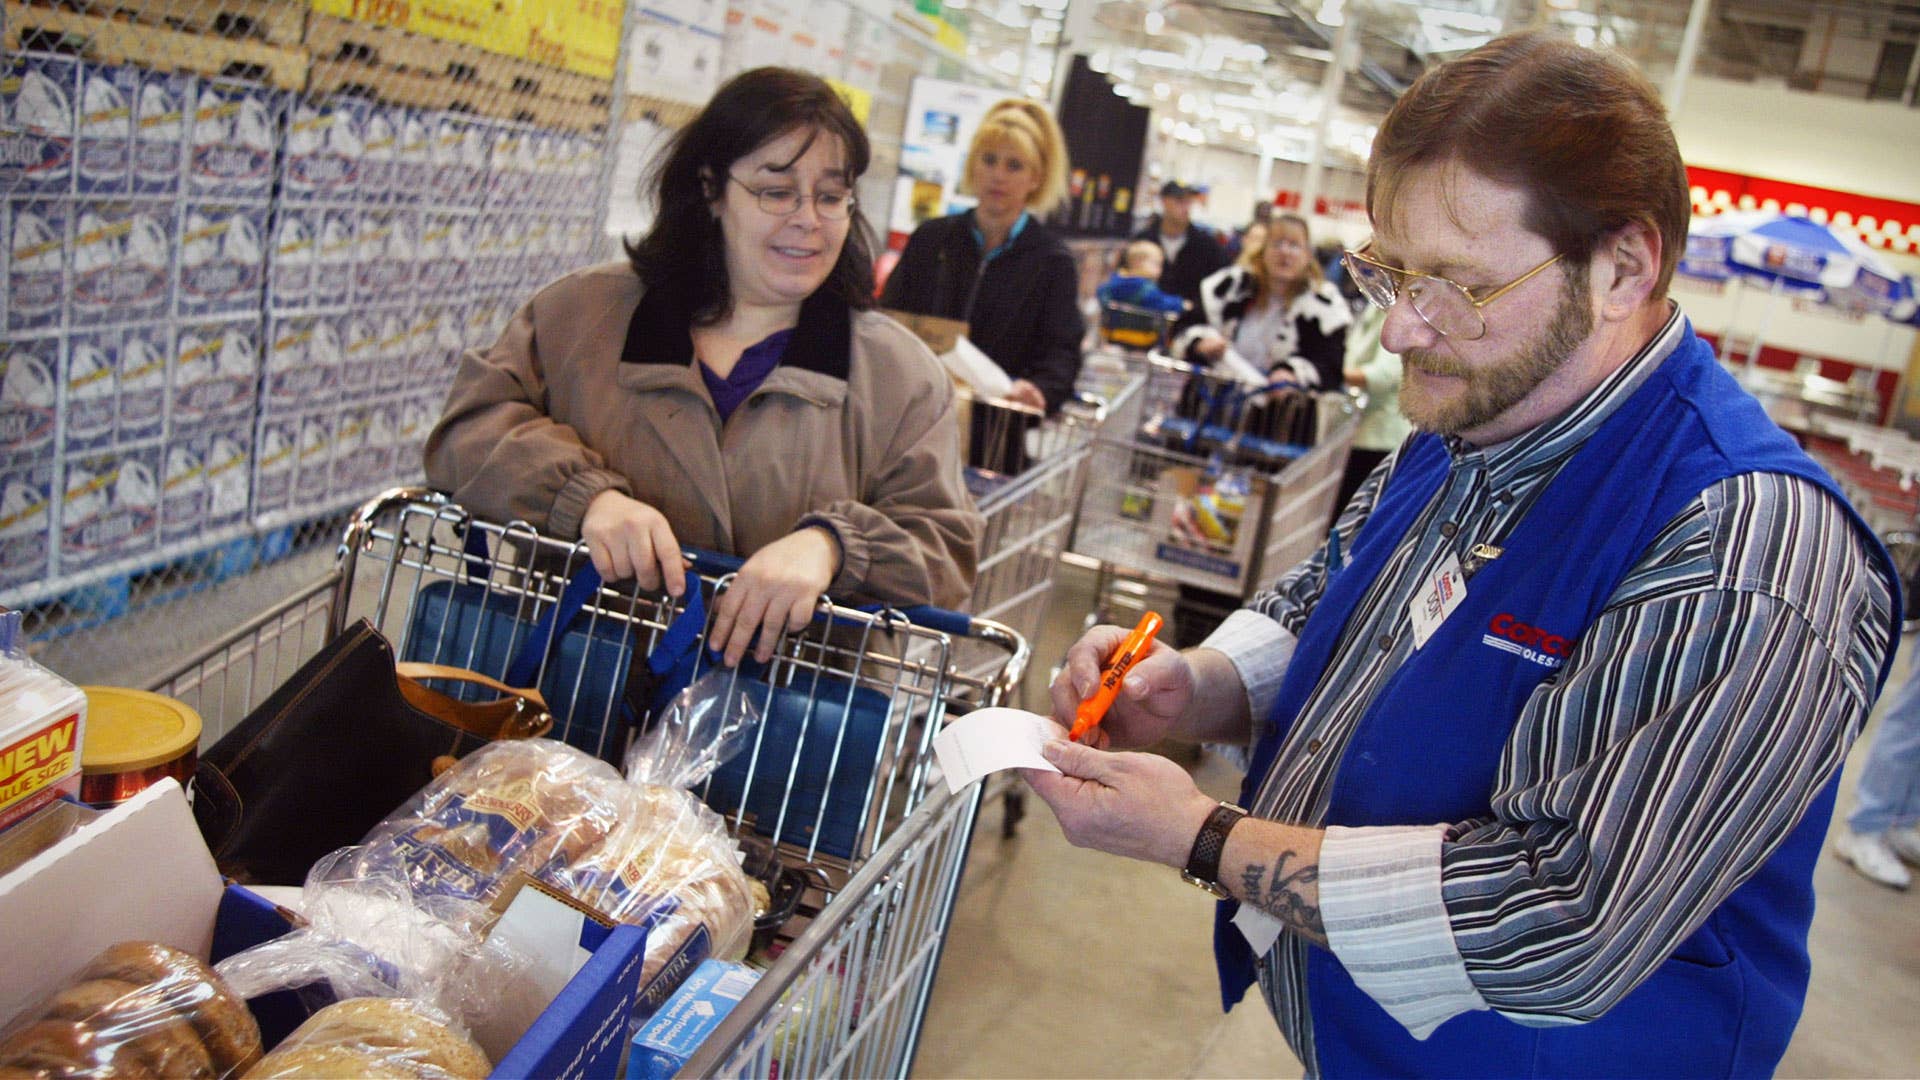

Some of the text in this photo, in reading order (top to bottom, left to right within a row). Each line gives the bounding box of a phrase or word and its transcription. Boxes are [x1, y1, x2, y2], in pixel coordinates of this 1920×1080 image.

[1103, 651, 1134, 690] HI-LITER
[0, 721, 76, 783] NEW
[0, 756, 69, 801] LUE SIZE
